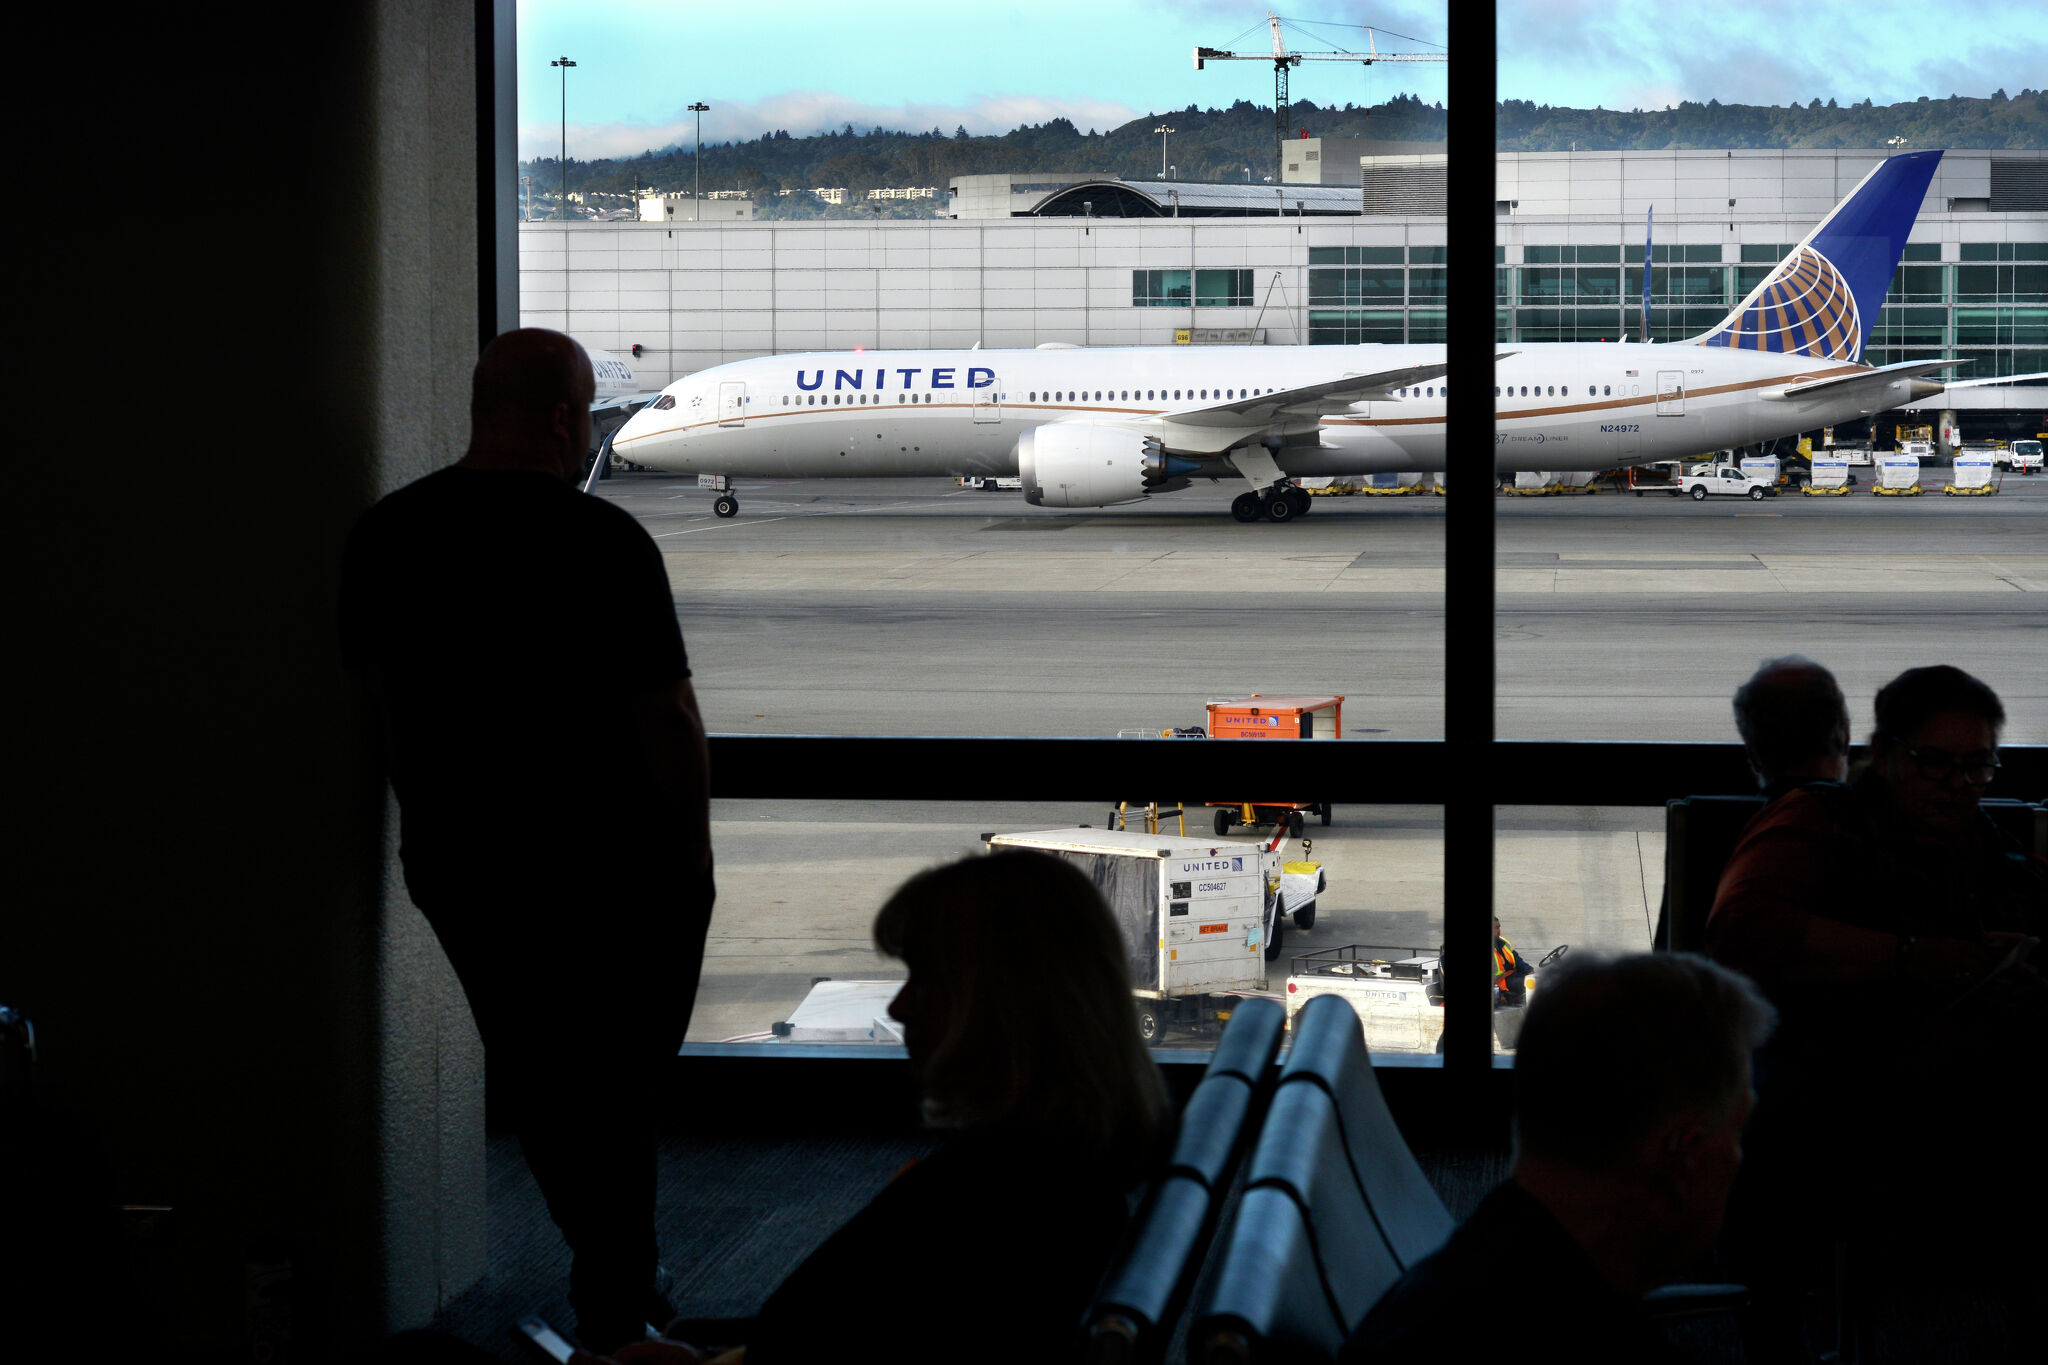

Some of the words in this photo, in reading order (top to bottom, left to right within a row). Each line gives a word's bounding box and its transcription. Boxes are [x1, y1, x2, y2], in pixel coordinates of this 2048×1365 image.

[591, 360, 632, 379] UNITED
[796, 367, 996, 391] UNITED
[1600, 424, 1640, 433] N24972
[1225, 716, 1267, 725] UNITED
[1183, 861, 1230, 872] UNITED
[1198, 882, 1227, 892] CC504627
[1365, 991, 1398, 999] UNITED
